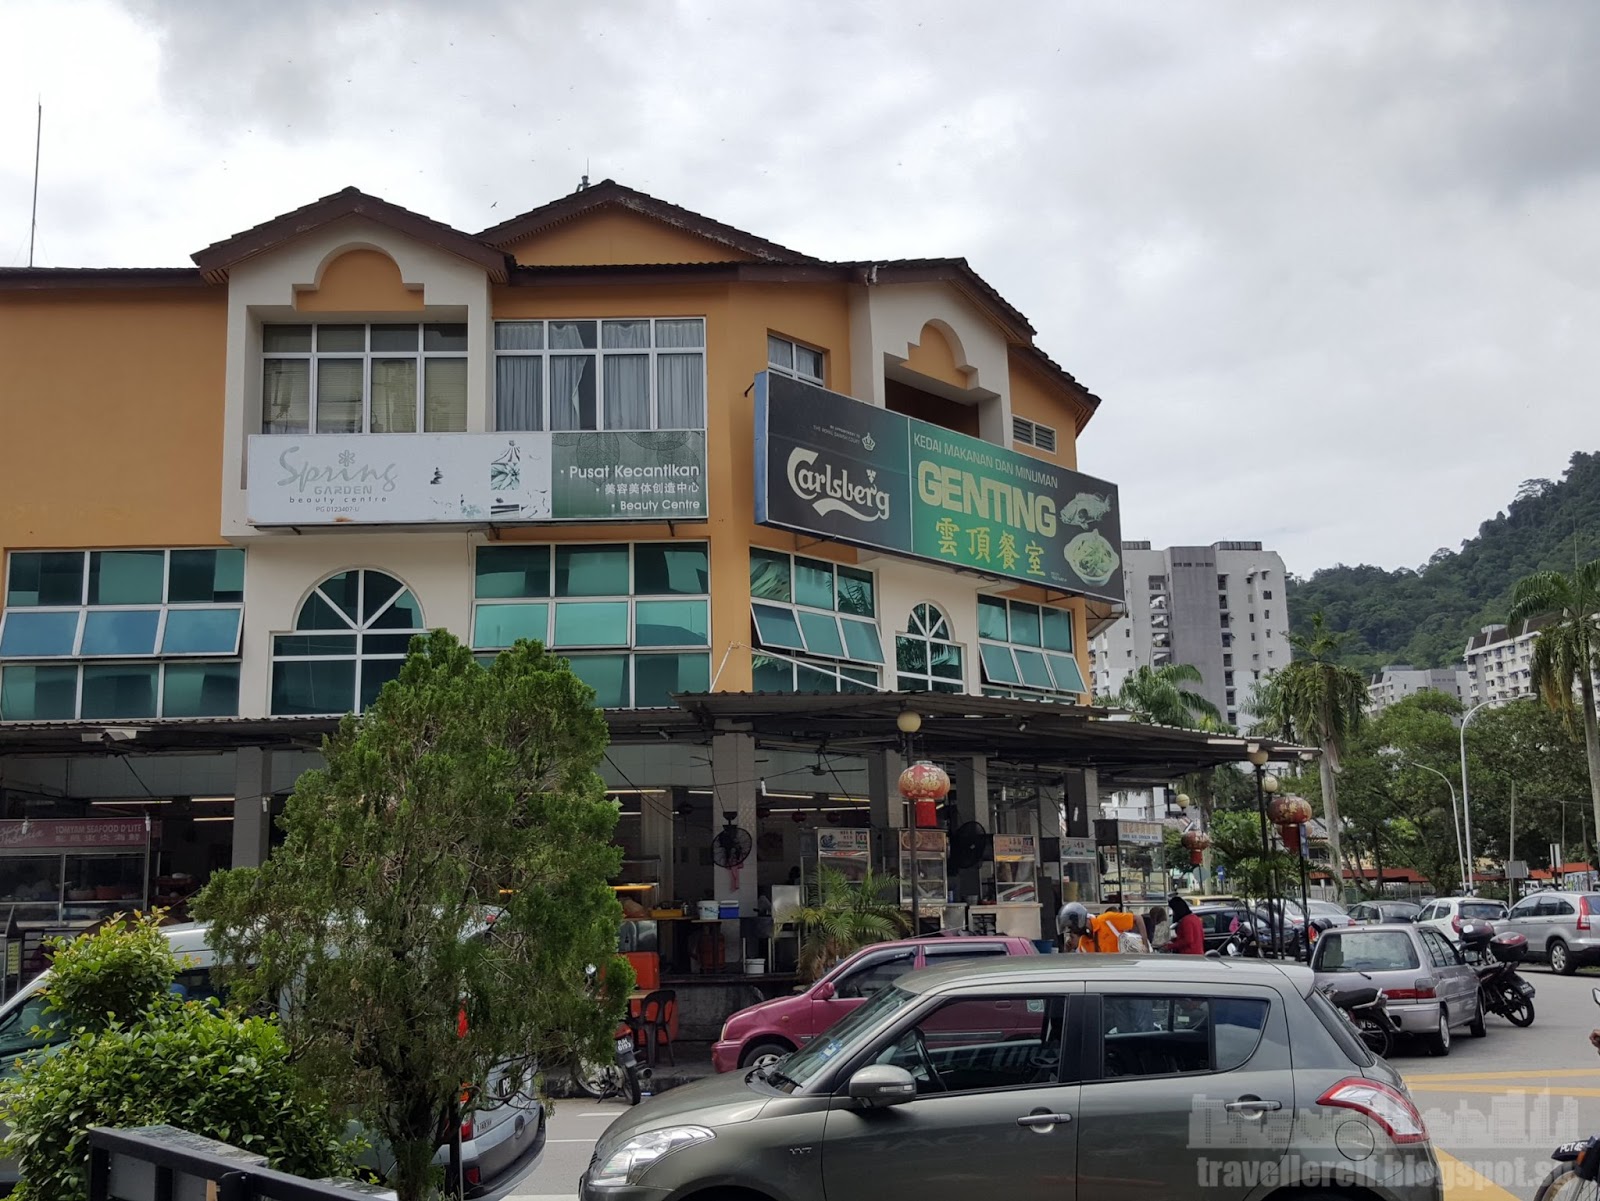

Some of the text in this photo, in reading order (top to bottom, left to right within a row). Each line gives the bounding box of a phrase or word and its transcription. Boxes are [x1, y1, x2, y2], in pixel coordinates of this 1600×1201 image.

[914, 432, 1058, 489] KEDAI MAKANAN DAN MINUMAN
[276, 445, 399, 493] Spring
[569, 464, 700, 479] Pusat Kecantikan
[314, 485, 373, 495] GARDEN
[604, 482, 700, 496] 美容美体创造中心
[786, 446, 890, 522] Carlsberg
[289, 495, 388, 504] beauty centre
[620, 499, 700, 513] Beauty Centre
[917, 460, 1057, 538] GENTING
[935, 517, 1046, 577] 雲頂餐室
[55, 825, 86, 835] TOMYAM
[86, 824, 119, 834] SEAFOOD
